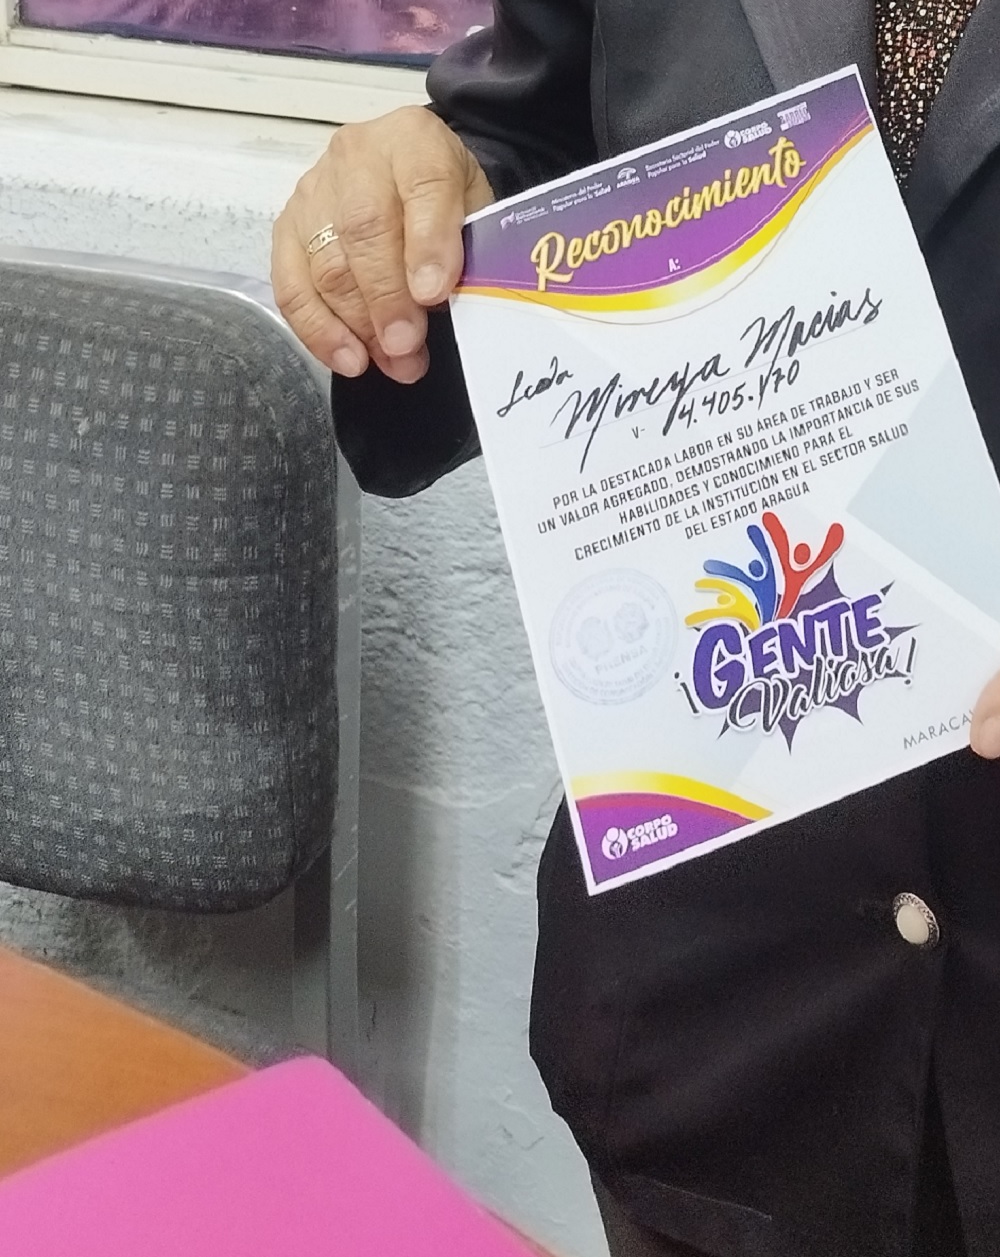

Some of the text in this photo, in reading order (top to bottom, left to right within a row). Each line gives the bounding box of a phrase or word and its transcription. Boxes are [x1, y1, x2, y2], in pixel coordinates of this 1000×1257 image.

[530, 136, 807, 291] Reconocimiento
[668, 257, 682, 273] A:
[537, 378, 920, 534] UN VALOR AGREGADO, DEMOSTRANDO LA IMPORTANCIA DE SUS
[549, 353, 731, 474] Mireya
[553, 368, 900, 509] POR LA DESTACADA LABOR EN SU ÁREA DE TRABAJO Y SER
[574, 423, 909, 561] CRECIMIENTO DE LA INSTITUCIÓN EN EL SECTOR SALUD
[618, 425, 854, 525] HABILIDADES Y CONOCIMIENO PARA EL
[685, 481, 811, 540] DEL ESTADO ARAGUA
[727, 636, 917, 733] Valiosa!
[903, 709, 973, 750] MARACA
[627, 813, 672, 840] CORPO
[631, 822, 678, 852] SALUD
